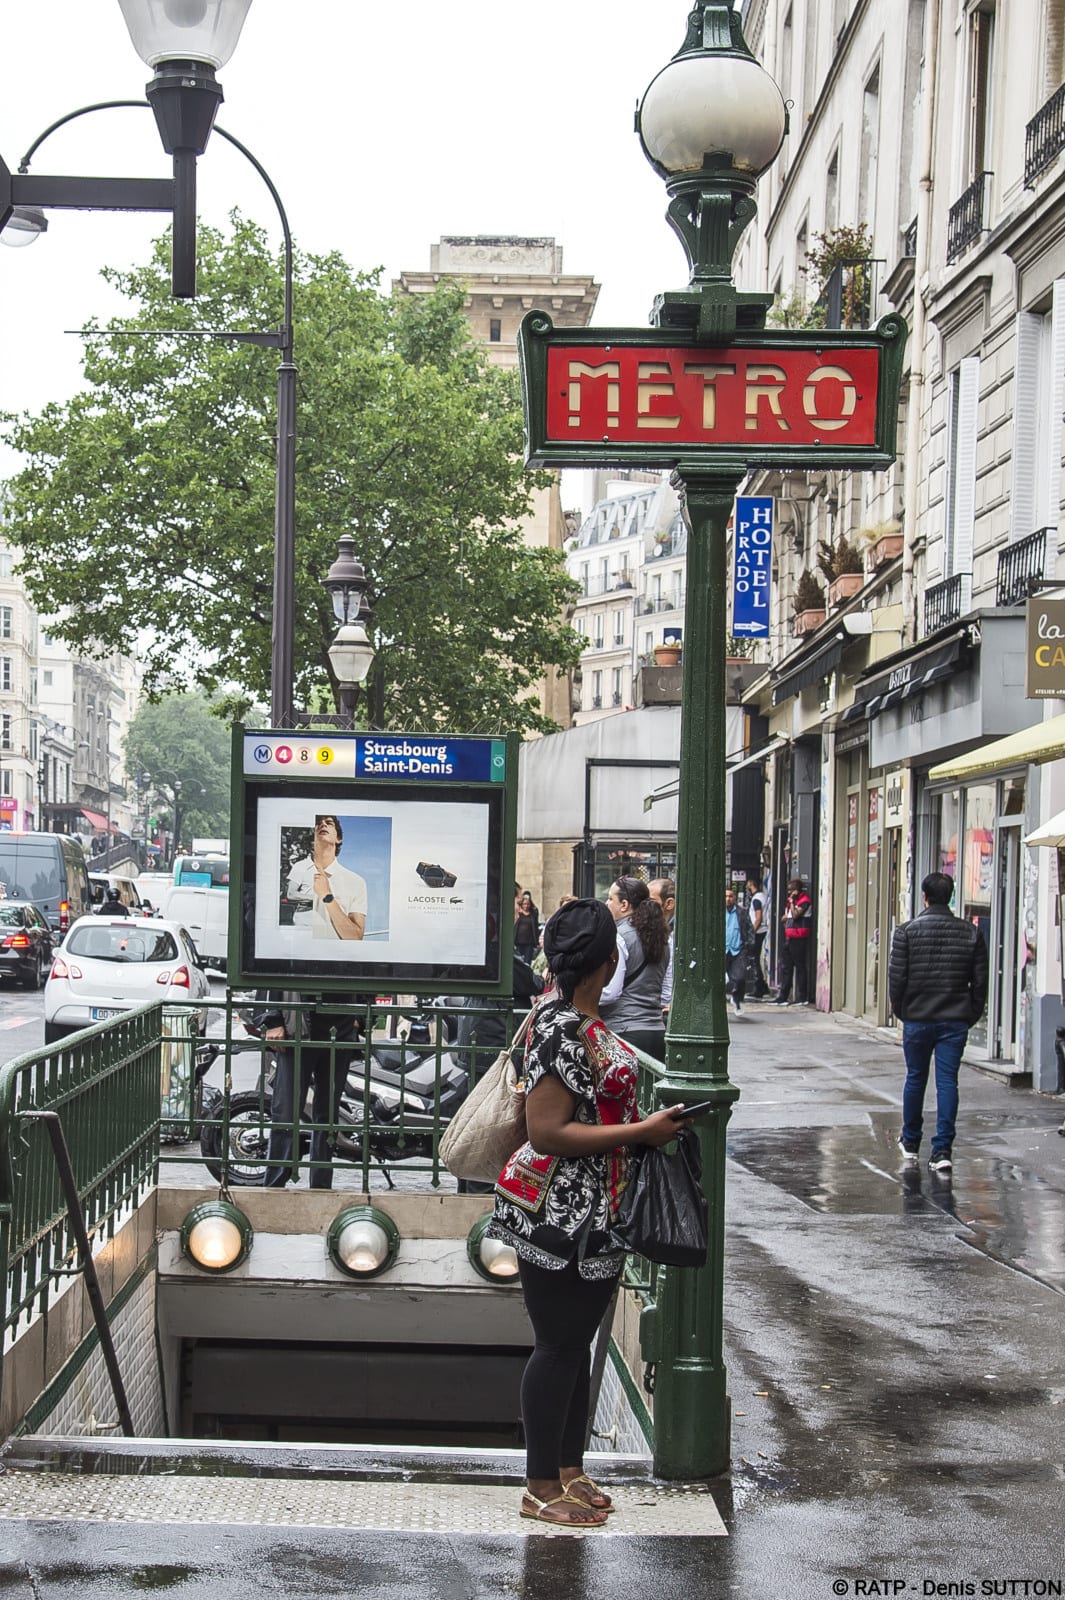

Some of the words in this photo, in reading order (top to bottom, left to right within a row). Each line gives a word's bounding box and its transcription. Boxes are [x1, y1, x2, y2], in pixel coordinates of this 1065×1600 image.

[568, 361, 856, 431] METRO
[736, 521, 750, 593] PRADO
[751, 507, 771, 608] HOTEL
[1038, 613, 1065, 639] la
[279, 749, 287, 760] 4
[300, 750, 309, 761] 8
[321, 751, 329, 762] 9
[364, 740, 447, 760] Strasbourg
[364, 758, 453, 774] Saint-Denis
